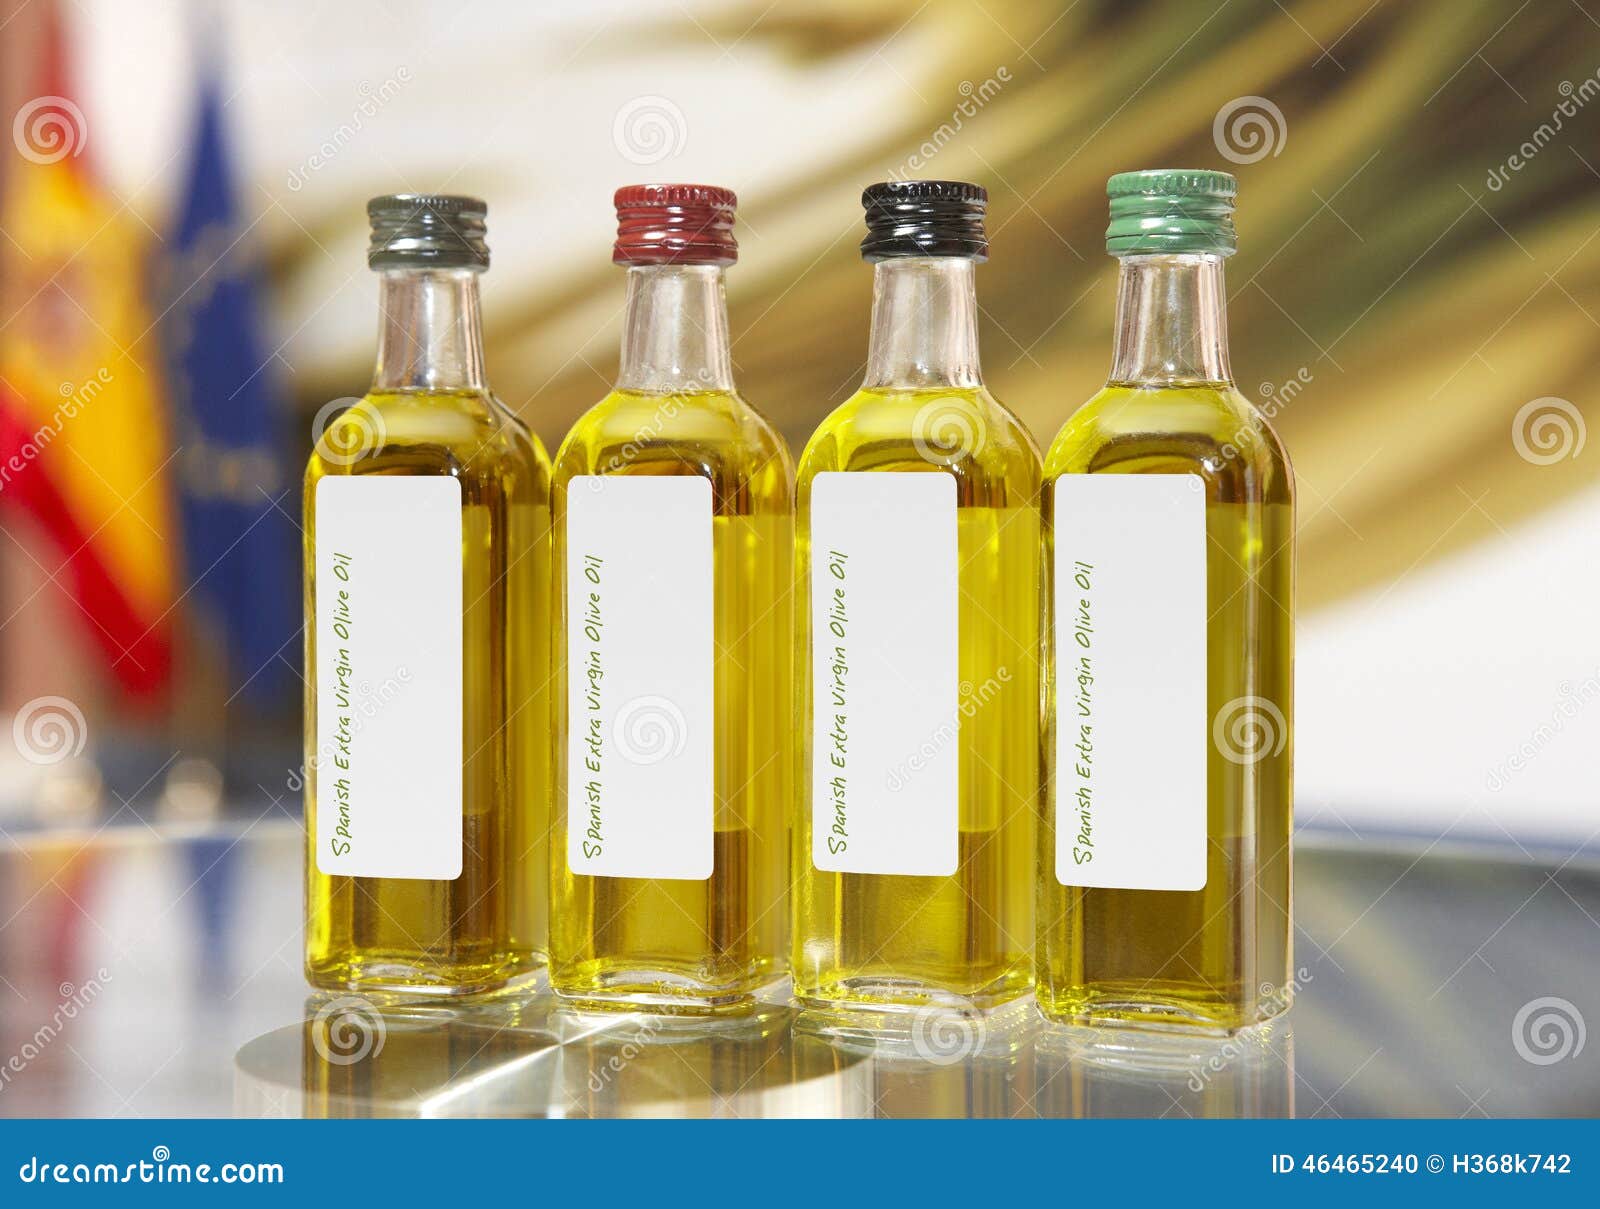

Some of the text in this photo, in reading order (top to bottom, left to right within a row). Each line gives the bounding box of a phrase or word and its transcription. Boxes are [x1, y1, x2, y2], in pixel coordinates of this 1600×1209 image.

[332, 552, 352, 856] Spanish Extra Virgin Olive Oil
[583, 555, 604, 859] Spanish Extra Virgin Olive Oil
[828, 551, 848, 855] Spanish Extra Virgin Olive Oil
[1073, 561, 1094, 865] Spanish Extra Virgin Olive Oil
